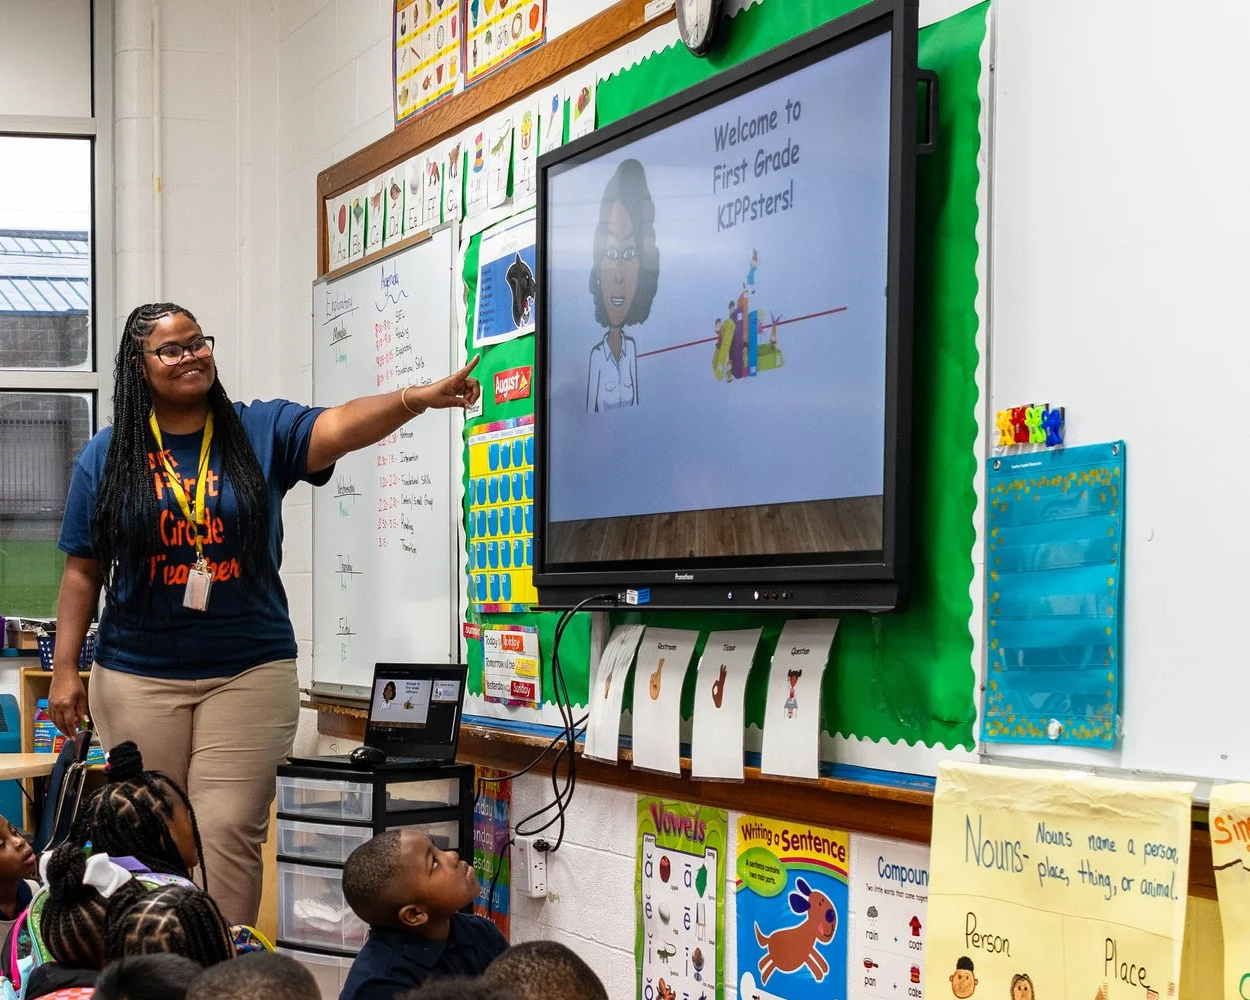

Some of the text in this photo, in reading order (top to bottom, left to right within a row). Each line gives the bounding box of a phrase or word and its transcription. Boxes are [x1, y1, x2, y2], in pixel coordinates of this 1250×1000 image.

[714, 98, 801, 152] Welcome to
[713, 138, 799, 194] First Grade
[717, 179, 794, 232] KIPPsters!
[496, 371, 520, 398] August
[658, 642, 677, 651] Restroom
[791, 647, 810, 656] Question
[514, 683, 530, 697] Sunday
[650, 802, 706, 843] Vowels
[742, 822, 846, 863] Writing a Sentence
[1036, 822, 1073, 847] Nouns
[1088, 834, 1117, 853] name
[1127, 838, 1136, 855] a
[878, 856, 929, 887] Compoun
[1121, 877, 1134, 892] or
[1141, 872, 1178, 900] animal.
[866, 930, 922, 950] rain coat
[965, 912, 1149, 990] Person Place
[864, 975, 922, 998] pan cake
